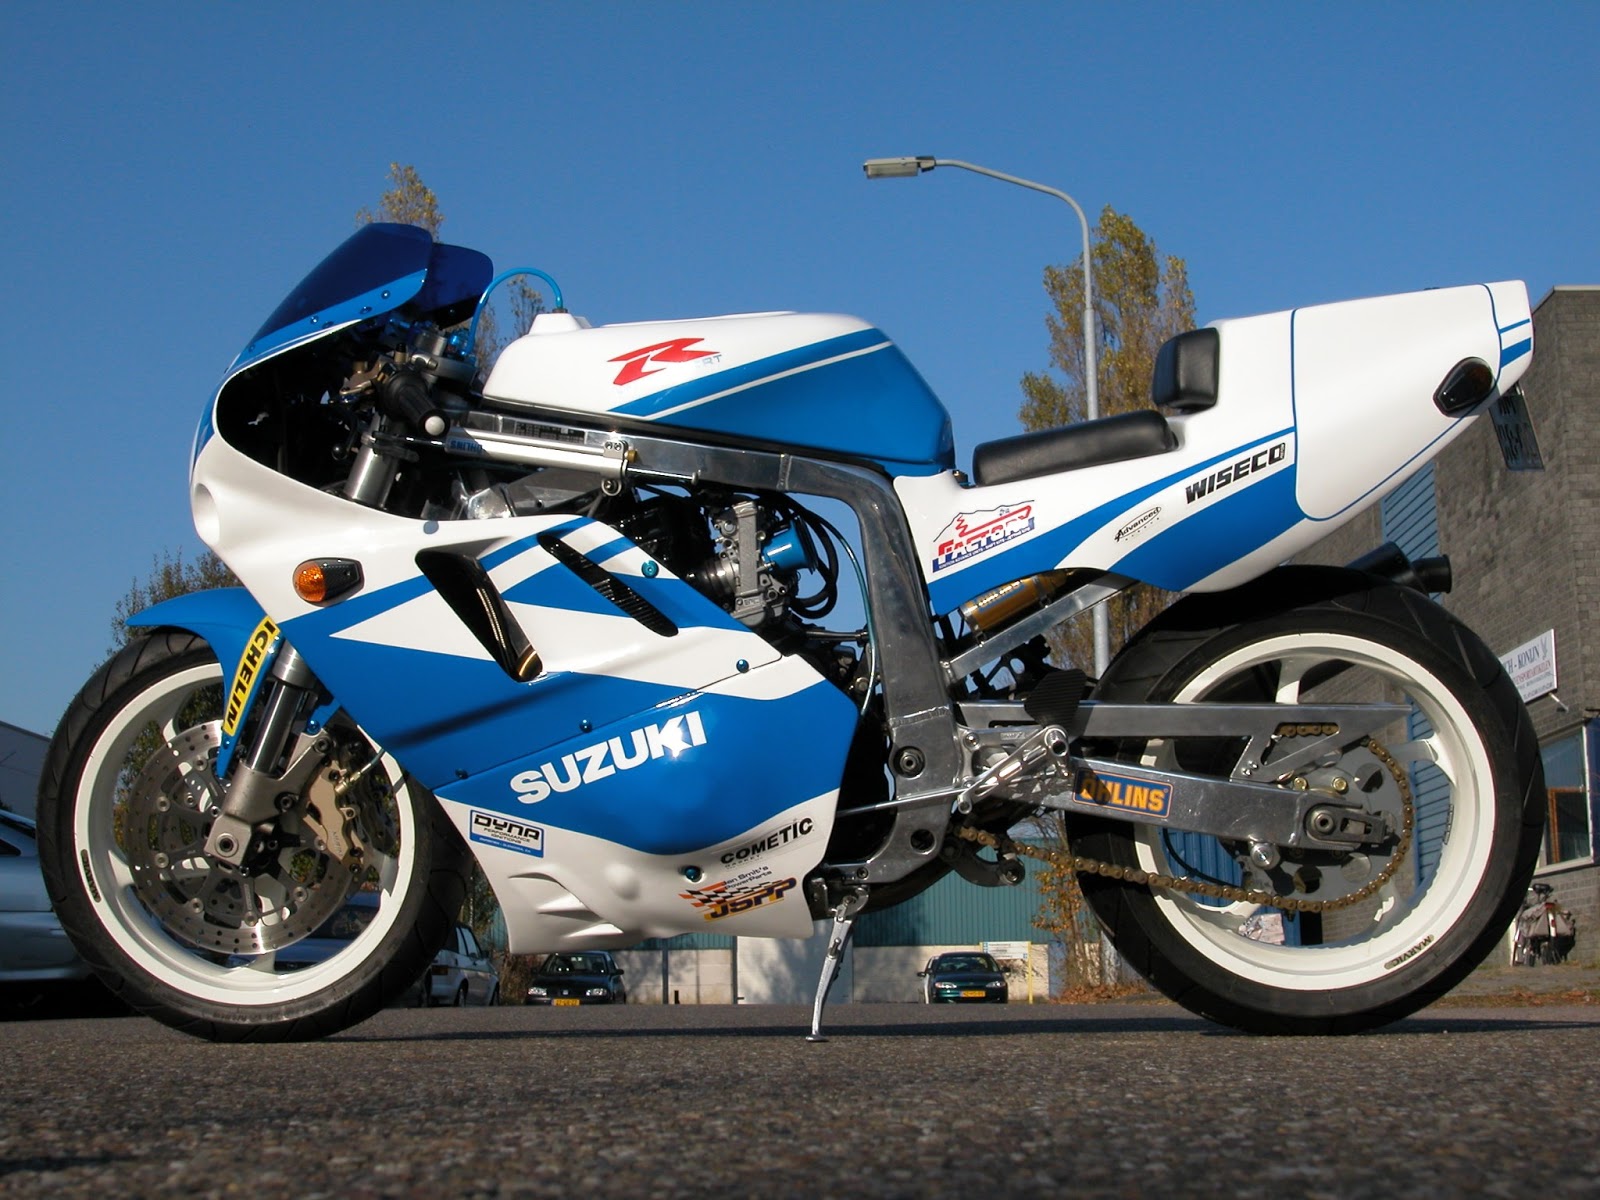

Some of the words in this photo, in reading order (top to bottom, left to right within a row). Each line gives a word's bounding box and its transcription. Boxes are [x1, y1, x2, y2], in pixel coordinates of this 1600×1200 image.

[1184, 442, 1287, 505] WISECO
[932, 505, 1036, 573] FACTORY
[1114, 507, 1160, 542] Advanced
[226, 620, 276, 730] ICHELIN
[509, 710, 708, 805] SUZUKI
[474, 813, 541, 841] DYNA
[483, 828, 531, 843] PERFORMANCE
[720, 817, 814, 865] COMETIC
[708, 877, 797, 920] JSPP
[1391, 935, 1432, 967] MARVIC
